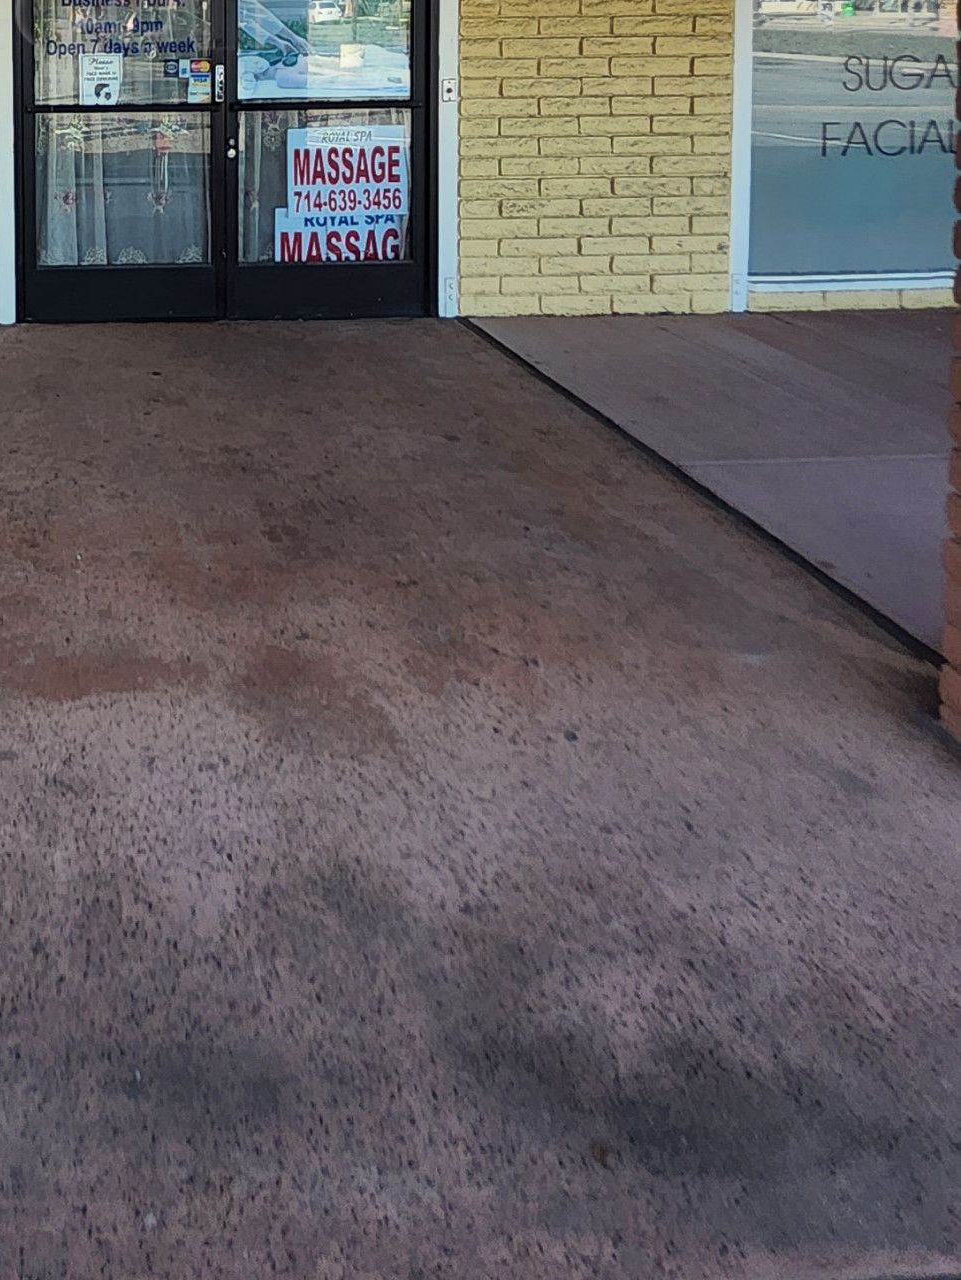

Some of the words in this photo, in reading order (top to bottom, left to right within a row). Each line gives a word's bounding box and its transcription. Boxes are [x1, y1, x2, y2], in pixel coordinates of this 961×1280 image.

[46, 39, 85, 59] Open
[90, 38, 99, 55] 7
[104, 38, 139, 58] days
[157, 37, 196, 54] week
[842, 53, 958, 92] SUGA
[321, 131, 351, 144] ROYAL
[353, 130, 373, 142] SPA
[821, 119, 958, 157] FACIAL
[293, 145, 401, 186] MASSAGE
[293, 187, 403, 213] 714-639-3456
